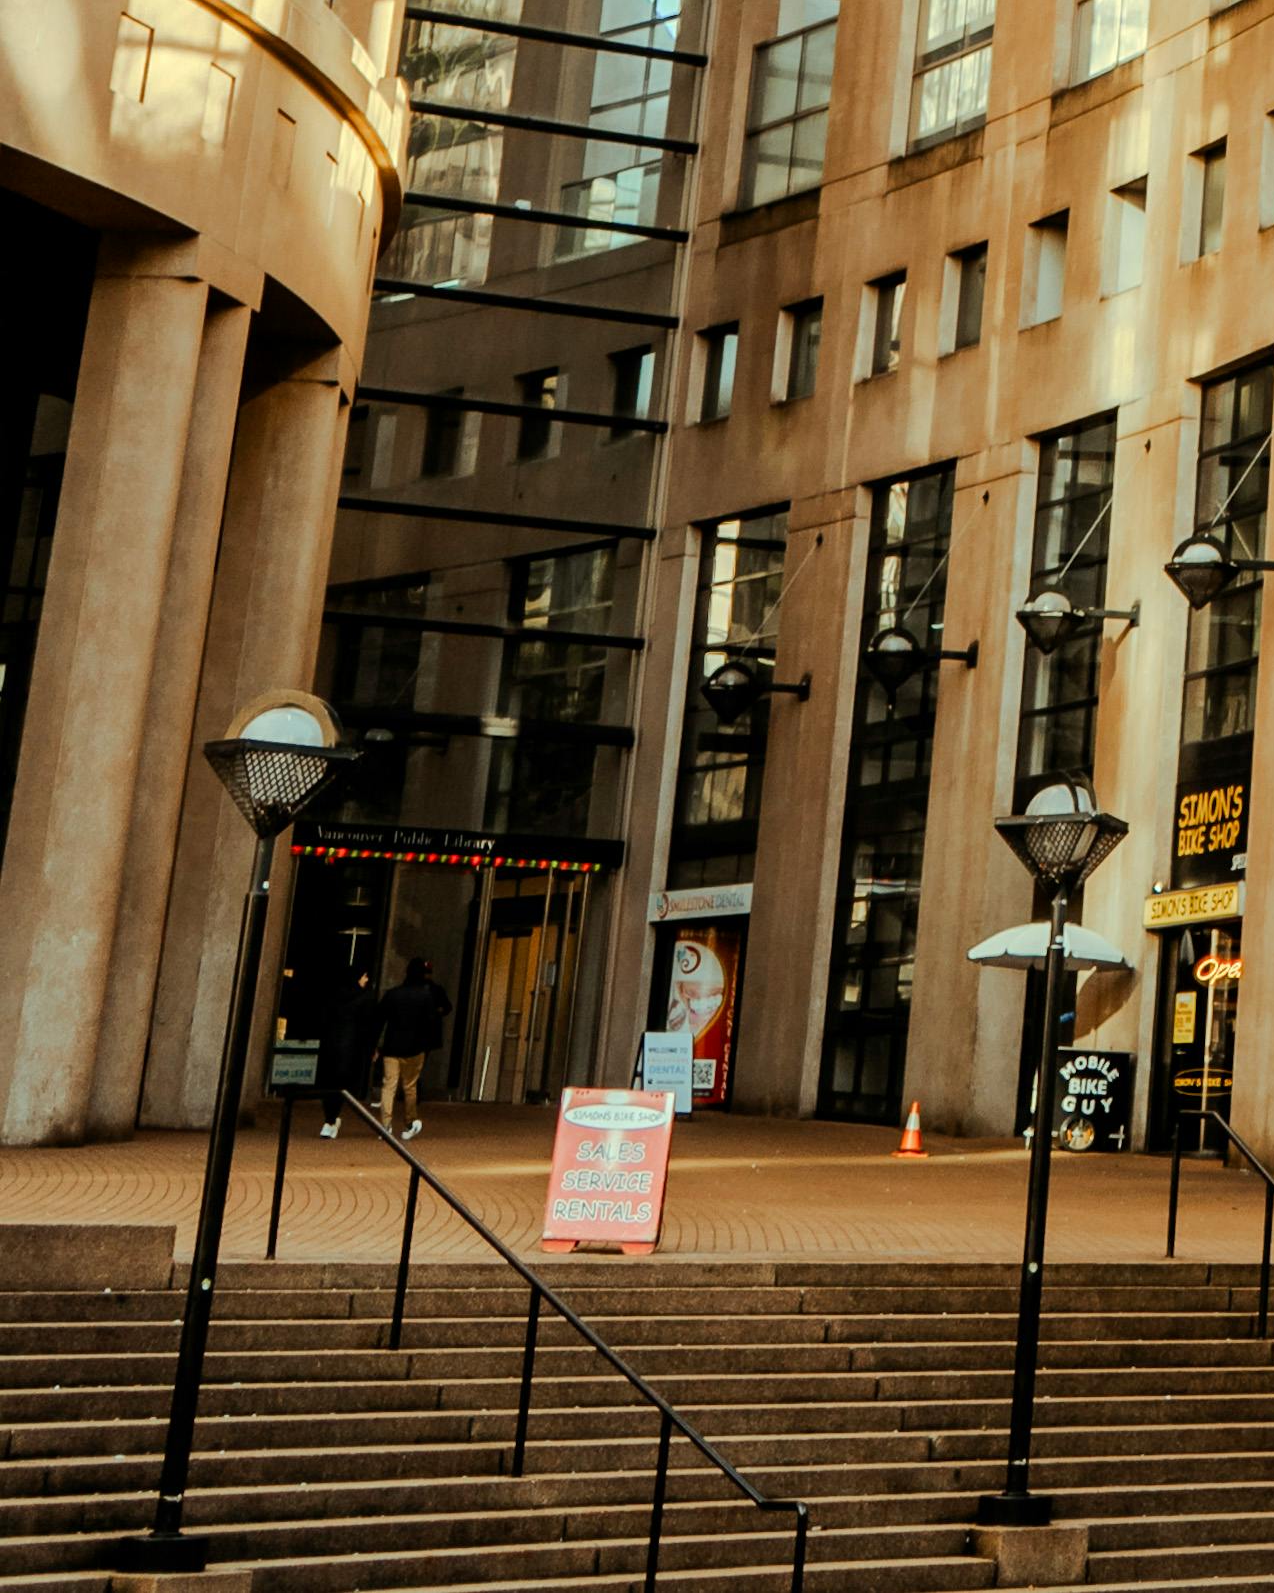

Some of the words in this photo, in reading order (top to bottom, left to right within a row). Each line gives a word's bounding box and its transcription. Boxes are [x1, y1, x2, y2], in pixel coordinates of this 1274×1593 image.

[1178, 785, 1243, 828] SIMON'S
[317, 824, 384, 843] Vancouver
[394, 830, 433, 846] Public
[444, 833, 496, 854] Library
[1178, 825, 1206, 856] BIKE
[1208, 820, 1240, 852] SHOP
[1151, 898, 1187, 919] SIMON'S
[1190, 893, 1208, 915] BIKE
[1211, 889, 1234, 912] SHOP
[1196, 957, 1241, 984] Ope
[1059, 1055, 1120, 1083] MOBILE
[1068, 1077, 1108, 1095] BIKE
[614, 1111, 636, 1122] BIKE
[1061, 1095, 1113, 1115] GUY
[577, 1140, 646, 1162] SALES
[561, 1169, 653, 1193] SERVICE
[553, 1198, 651, 1223] RENTALS
